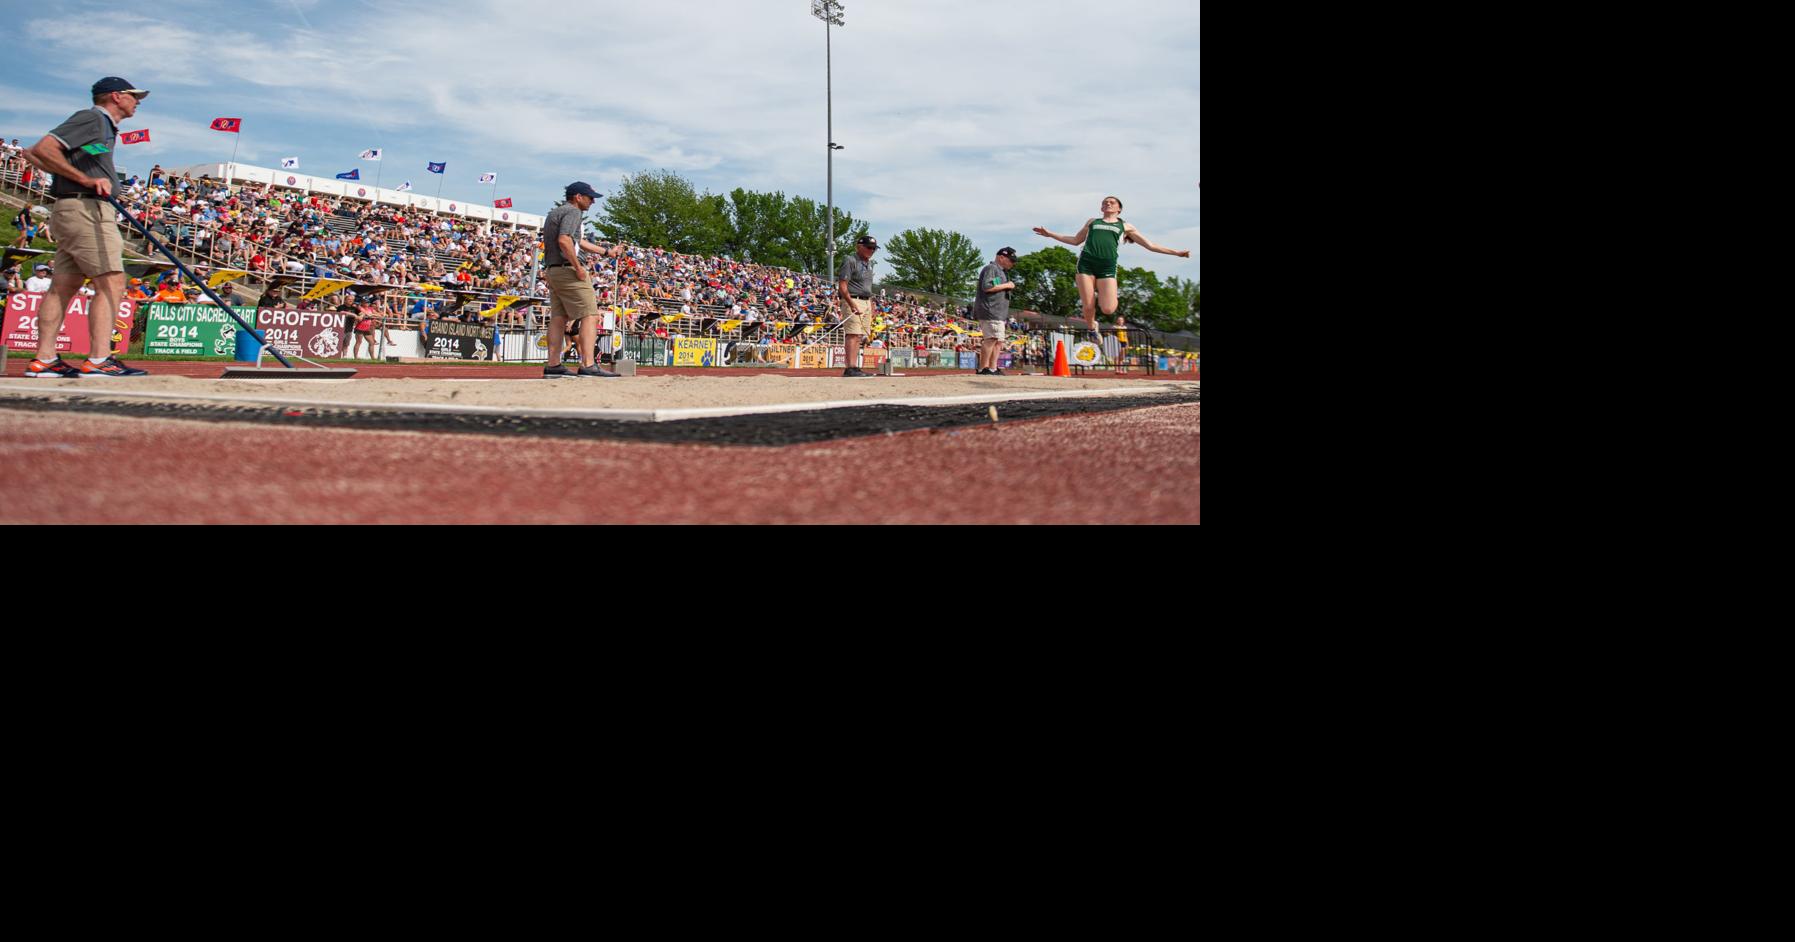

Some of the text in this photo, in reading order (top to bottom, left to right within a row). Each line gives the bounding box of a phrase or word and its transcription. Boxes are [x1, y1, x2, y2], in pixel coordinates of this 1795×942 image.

[149, 304, 176, 321] FALLS
[177, 305, 196, 322] CITY
[196, 306, 228, 323] SACRED
[258, 309, 345, 328] CROFTON
[157, 325, 199, 338] 2014
[265, 328, 298, 341] 2014
[431, 320, 448, 334] GRAND
[448, 322, 466, 336] ISLAND
[434, 337, 460, 349] 2014
[678, 339, 714, 349] KEARNEY
[625, 350, 641, 361] 2014
[679, 351, 694, 359] 2014
